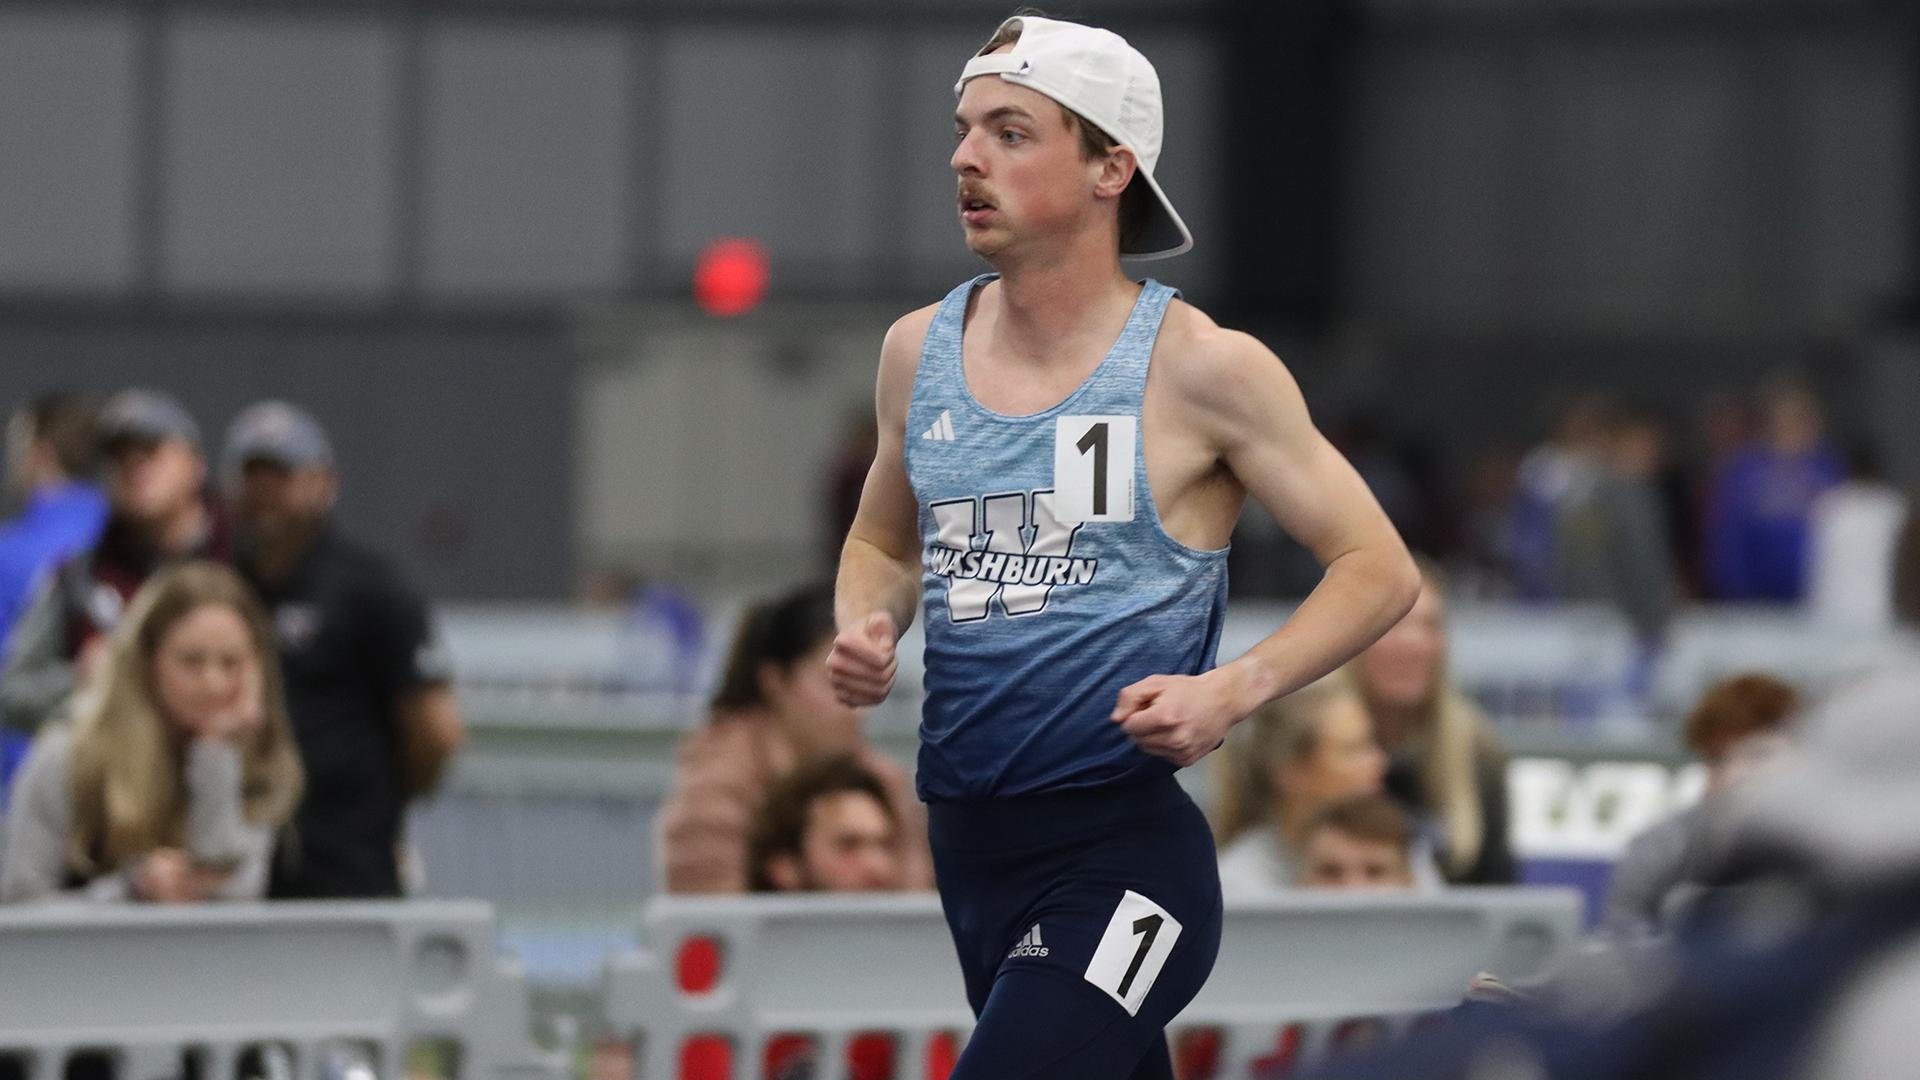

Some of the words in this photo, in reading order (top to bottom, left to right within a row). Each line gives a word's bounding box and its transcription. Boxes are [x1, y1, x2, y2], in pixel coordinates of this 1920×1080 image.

[1076, 422, 1109, 515] 1
[930, 489, 1085, 623] W
[931, 546, 1098, 585] WASHBURN
[1117, 913, 1164, 999] 1
